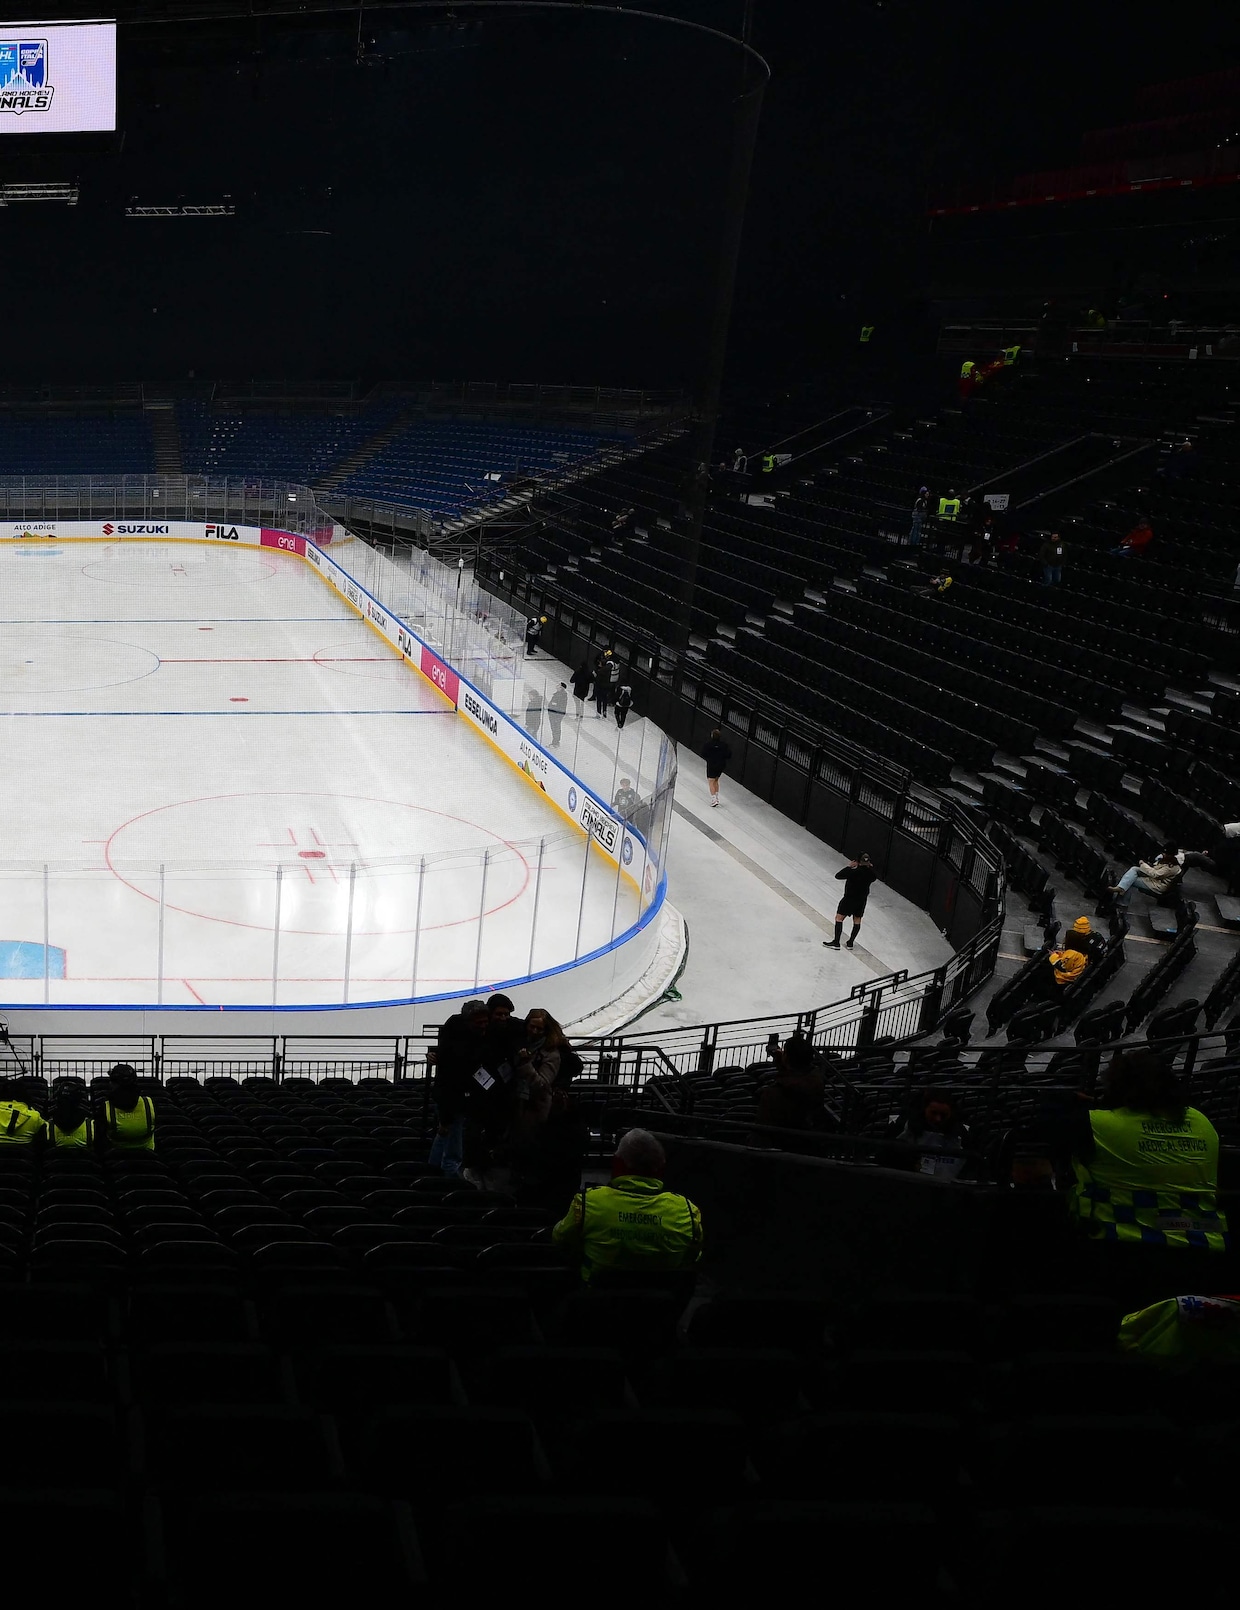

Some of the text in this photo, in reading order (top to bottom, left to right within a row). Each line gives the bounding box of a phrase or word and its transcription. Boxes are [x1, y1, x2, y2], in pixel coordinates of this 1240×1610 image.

[117, 525, 169, 534] SUZUKI
[205, 524, 239, 540] FILA
[278, 535, 296, 551] enel
[398, 628, 412, 657] FILA
[431, 664, 447, 689] enel
[464, 693, 498, 737] ESSELUNGA
[582, 808, 615, 847] FINALS
[1141, 1121, 1192, 1134] EMERGENCY
[1138, 1140, 1208, 1152] MEDICAL SERVICE
[618, 1211, 662, 1226] EMERGENCY
